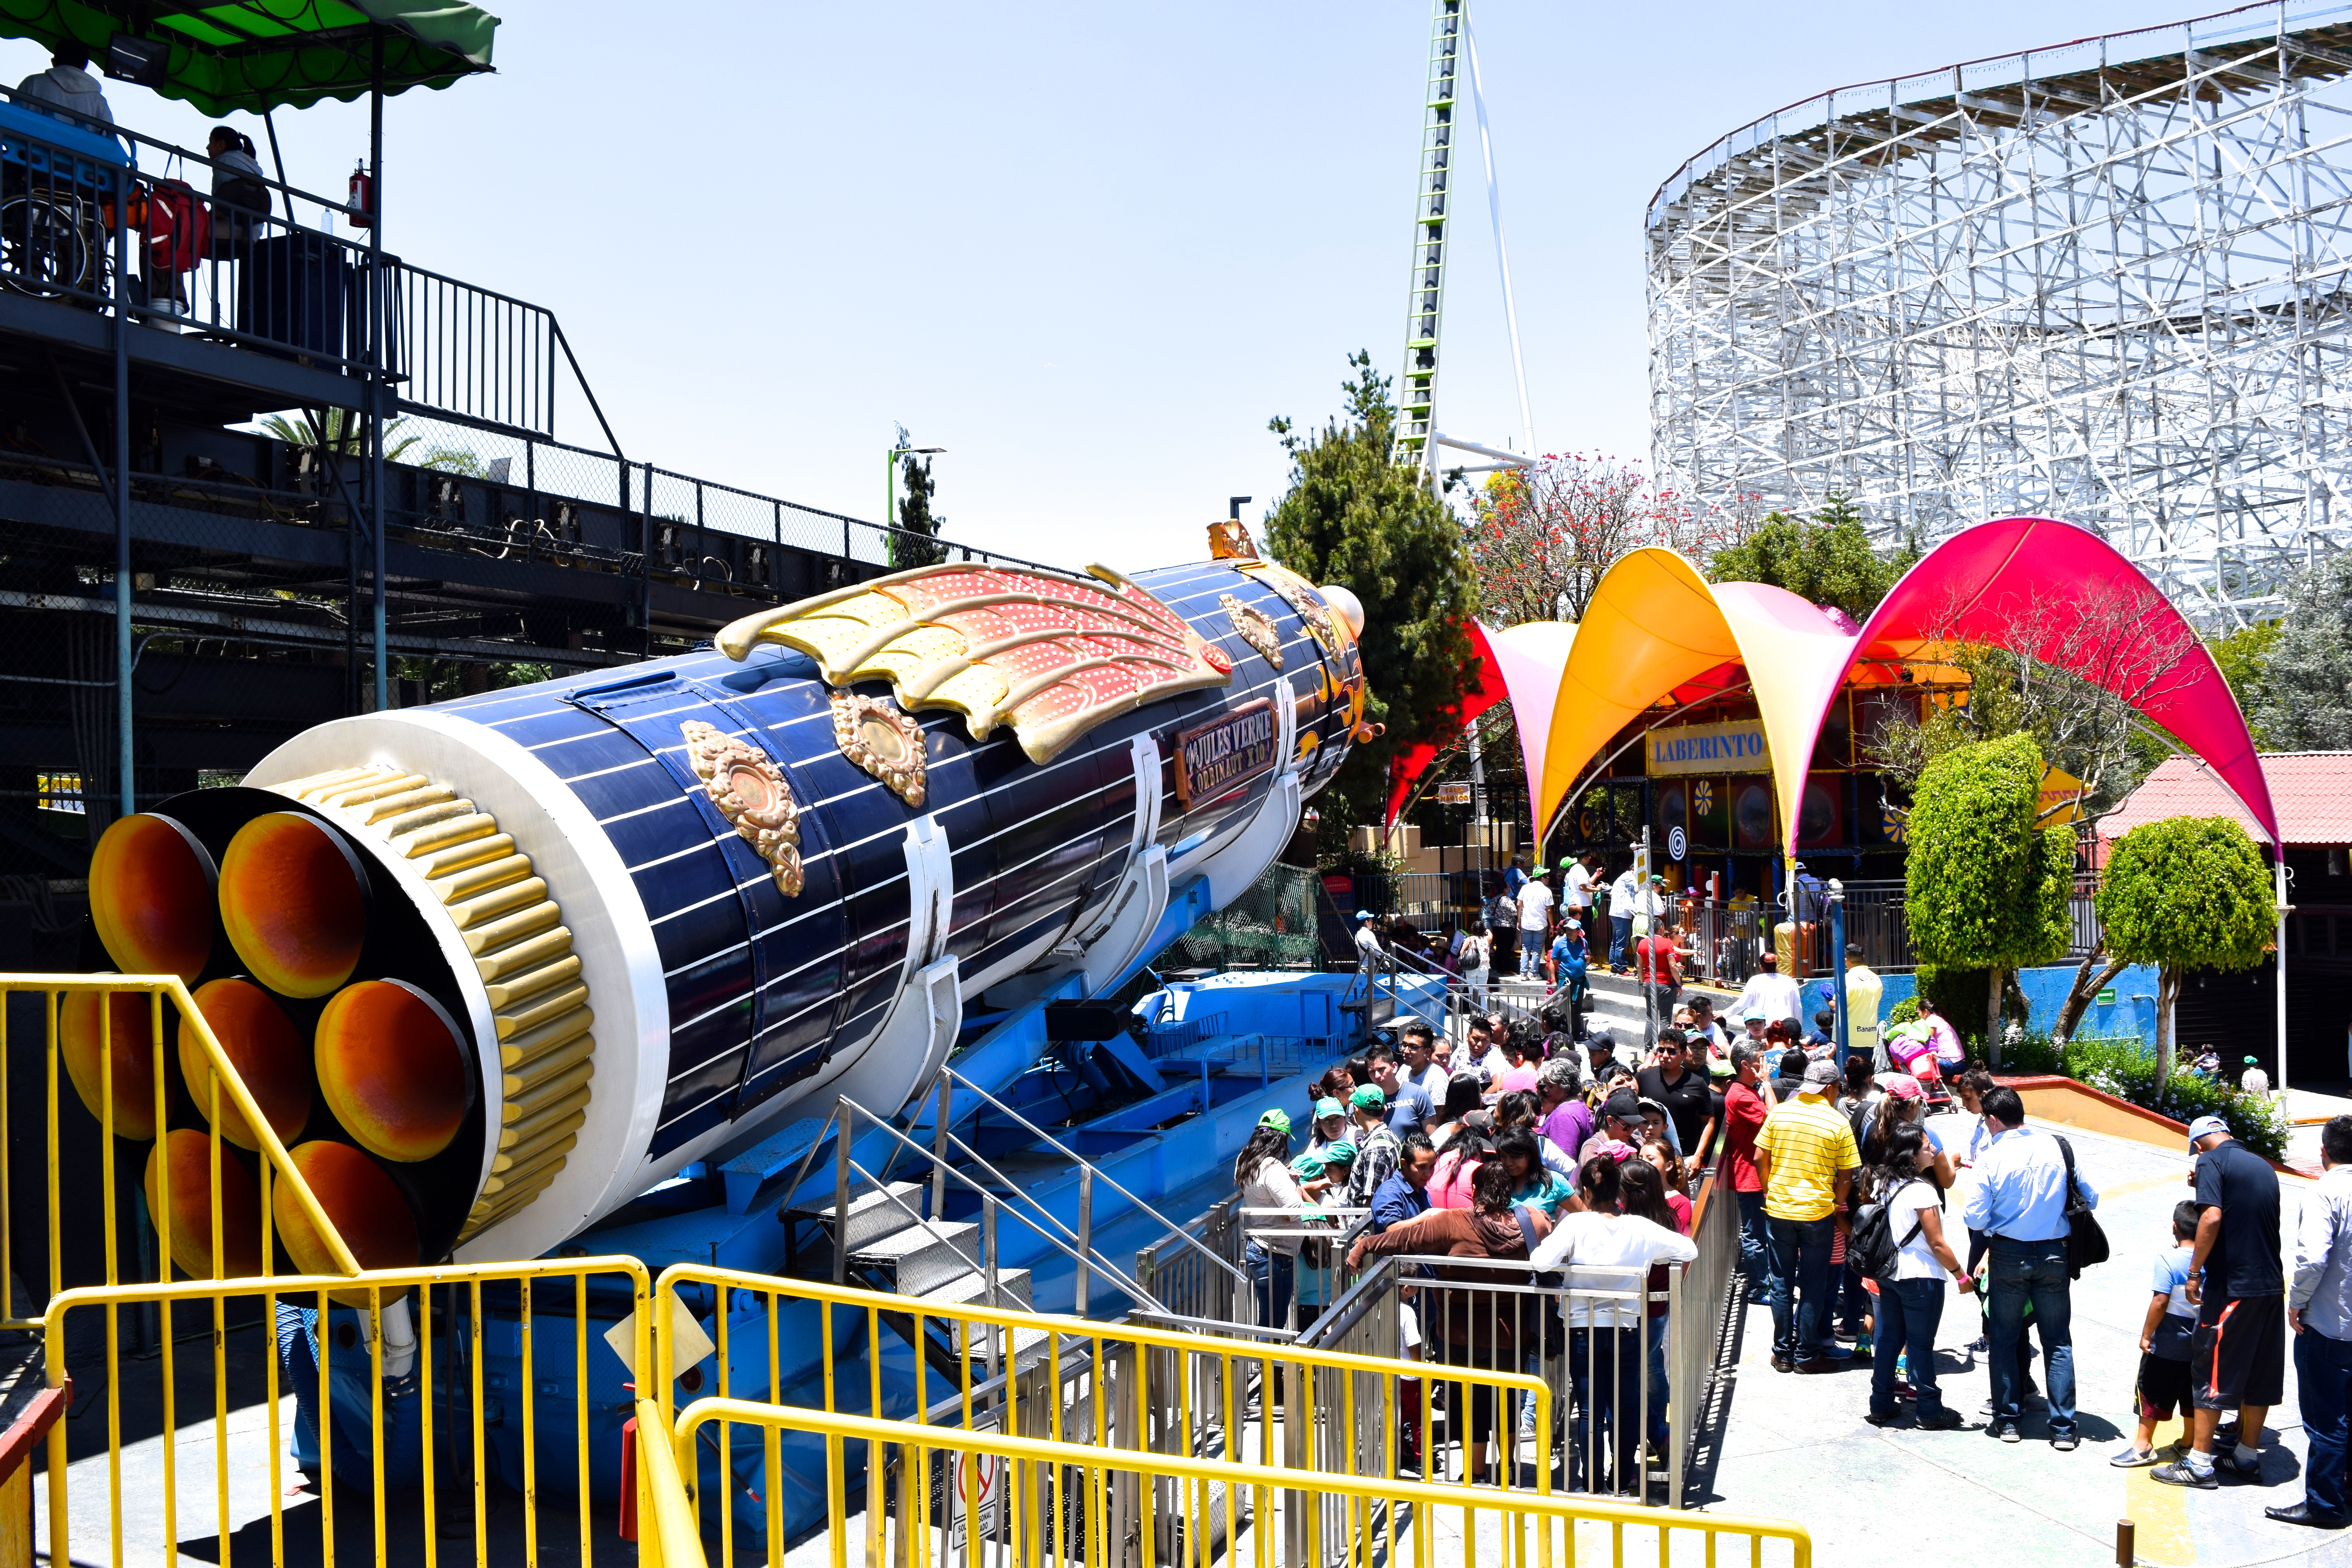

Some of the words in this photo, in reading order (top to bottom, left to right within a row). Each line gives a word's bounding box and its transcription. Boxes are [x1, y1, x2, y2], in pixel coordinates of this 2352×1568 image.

[1196, 726, 1231, 769] JULES
[1232, 710, 1271, 751] VERNE
[1655, 732, 1762, 762] LABERINTO
[1197, 752, 1242, 793] ORBINAUT
[1387, 1098, 1414, 1109] TODAY
[958, 1523, 967, 1533] SOL
